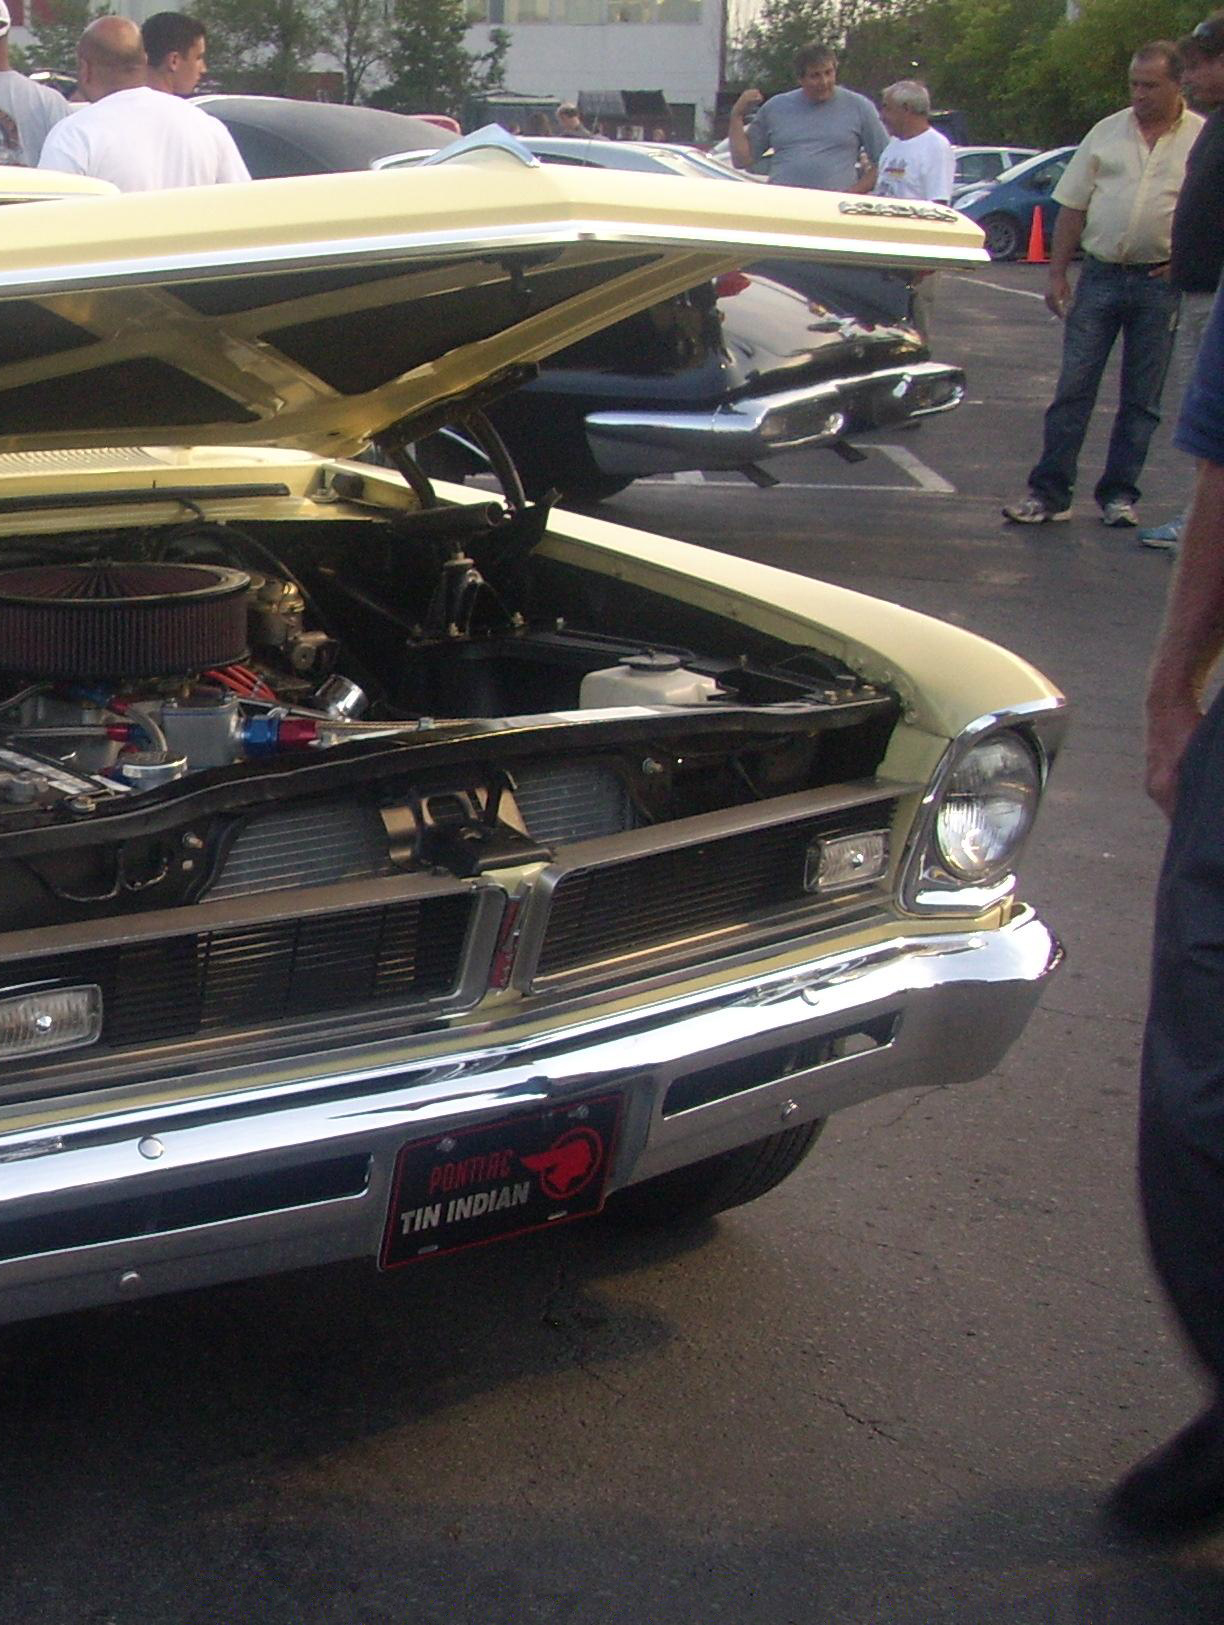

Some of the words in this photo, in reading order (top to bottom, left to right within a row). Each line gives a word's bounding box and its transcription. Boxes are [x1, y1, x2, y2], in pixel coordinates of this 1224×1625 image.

[431, 1150, 513, 1193] PONTIAC
[401, 1203, 442, 1235] TIN
[446, 1182, 530, 1224] INDIAN
